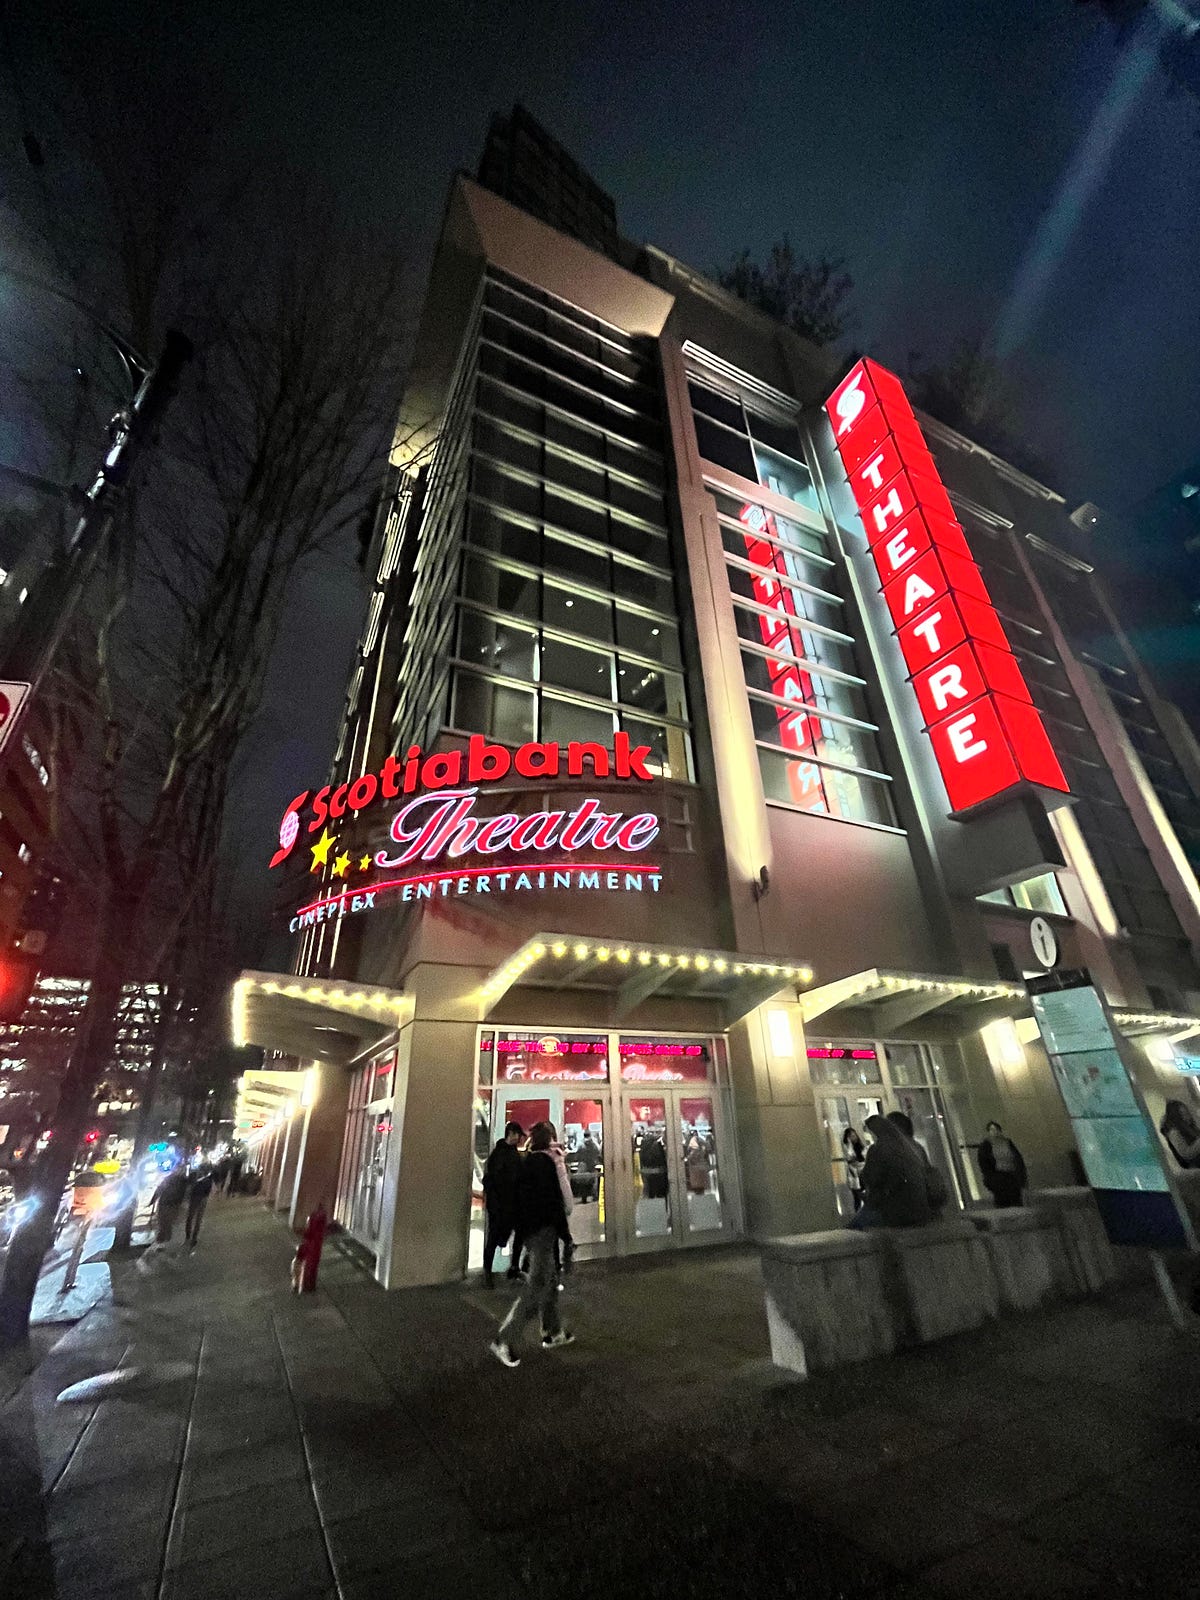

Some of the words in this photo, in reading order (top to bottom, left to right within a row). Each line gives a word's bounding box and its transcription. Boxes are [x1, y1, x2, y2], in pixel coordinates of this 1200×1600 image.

[862, 453, 987, 763] THEATRE
[309, 732, 654, 832] Scotiabank
[374, 787, 659, 868] Theatre
[289, 891, 376, 933] CINEPLEX
[402, 872, 663, 902] ENTERTAINMENT
